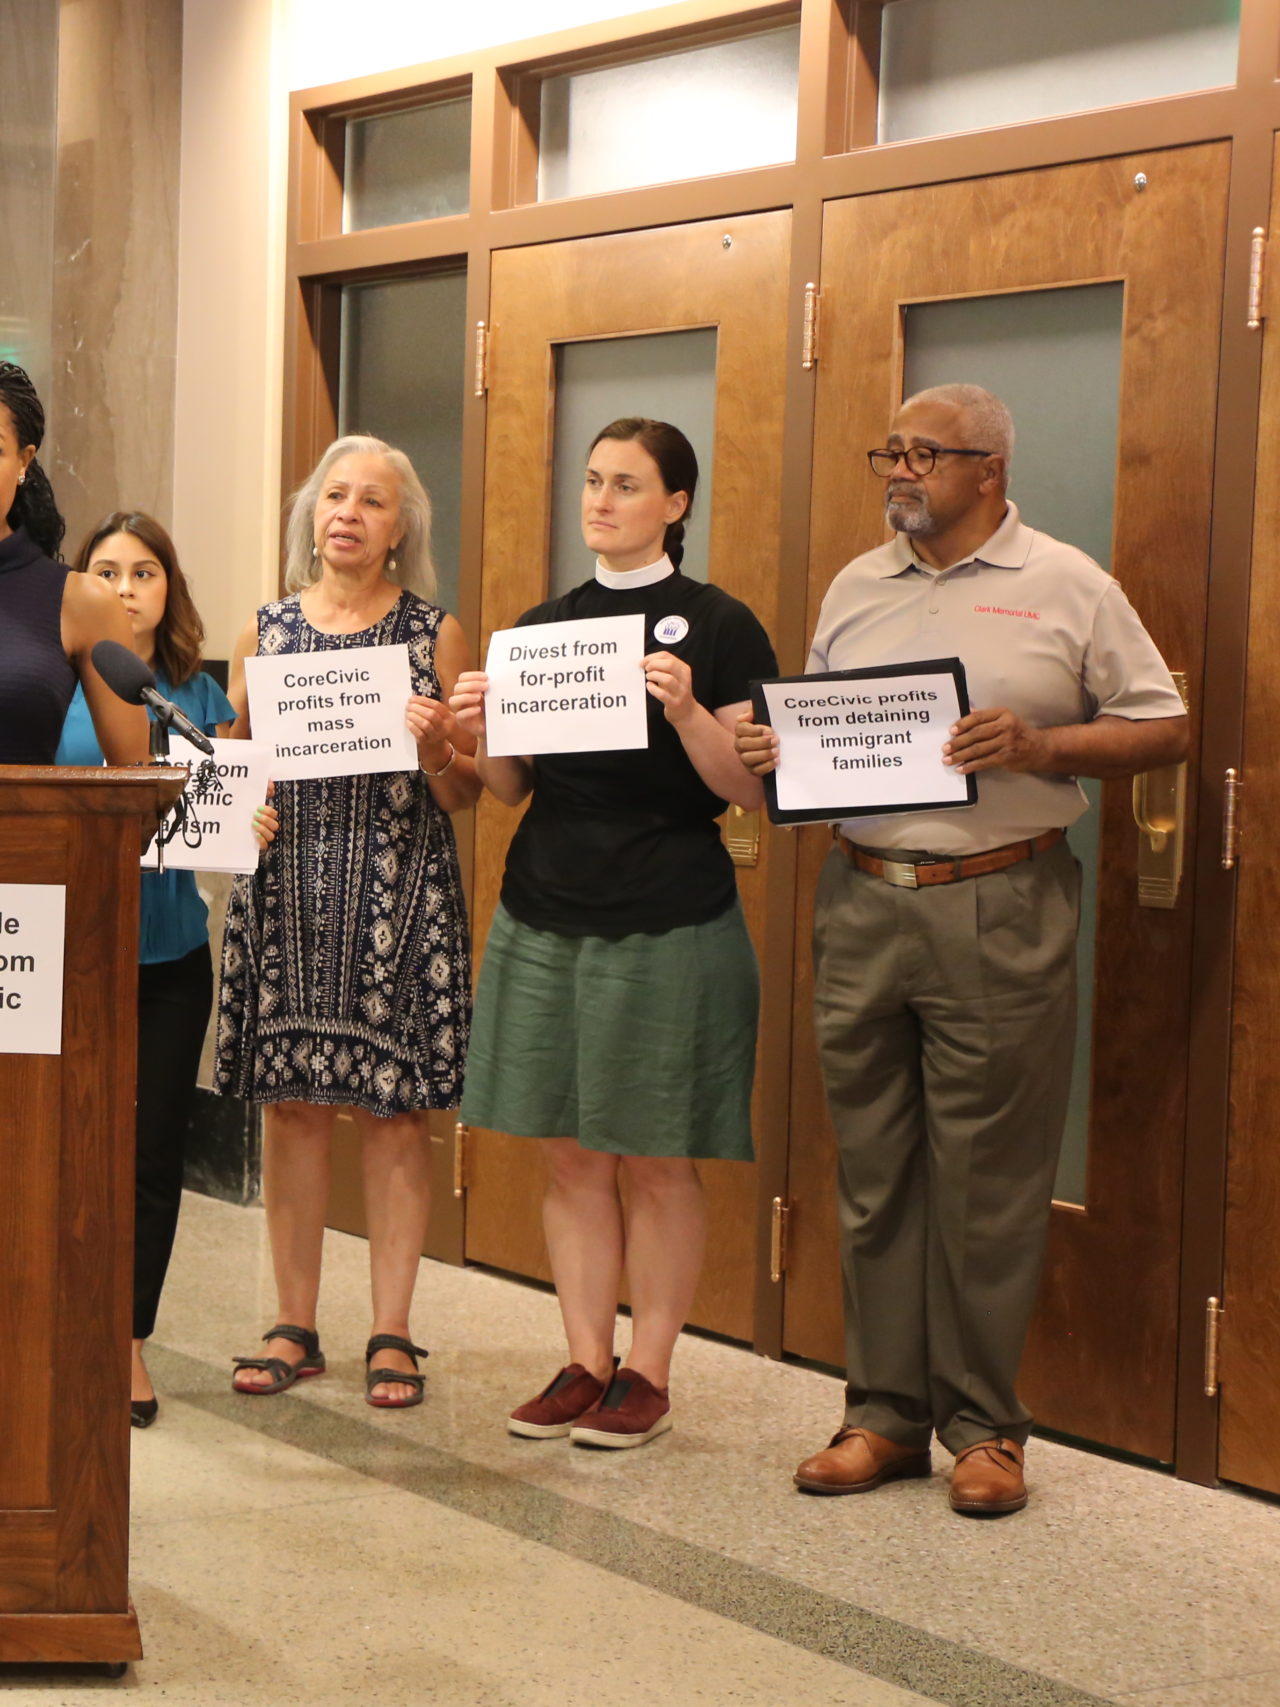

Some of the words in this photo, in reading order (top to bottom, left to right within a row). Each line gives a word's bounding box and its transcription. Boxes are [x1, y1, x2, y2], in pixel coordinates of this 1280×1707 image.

[974, 605, 991, 613] Clark
[509, 642, 568, 662] Divest
[572, 640, 618, 657] from
[283, 668, 370, 689] CoreCivic
[519, 665, 606, 689] for-profit
[277, 695, 334, 716] profits
[339, 692, 381, 707] from
[501, 692, 627, 715] incarceration
[784, 694, 873, 709] CoreCivic
[877, 690, 938, 706] profits
[307, 718, 355, 733] mass
[797, 714, 840, 728] from
[845, 708, 930, 725] detaining
[275, 736, 392, 758] incarceration
[820, 730, 913, 750] immigrant
[831, 753, 903, 771] families
